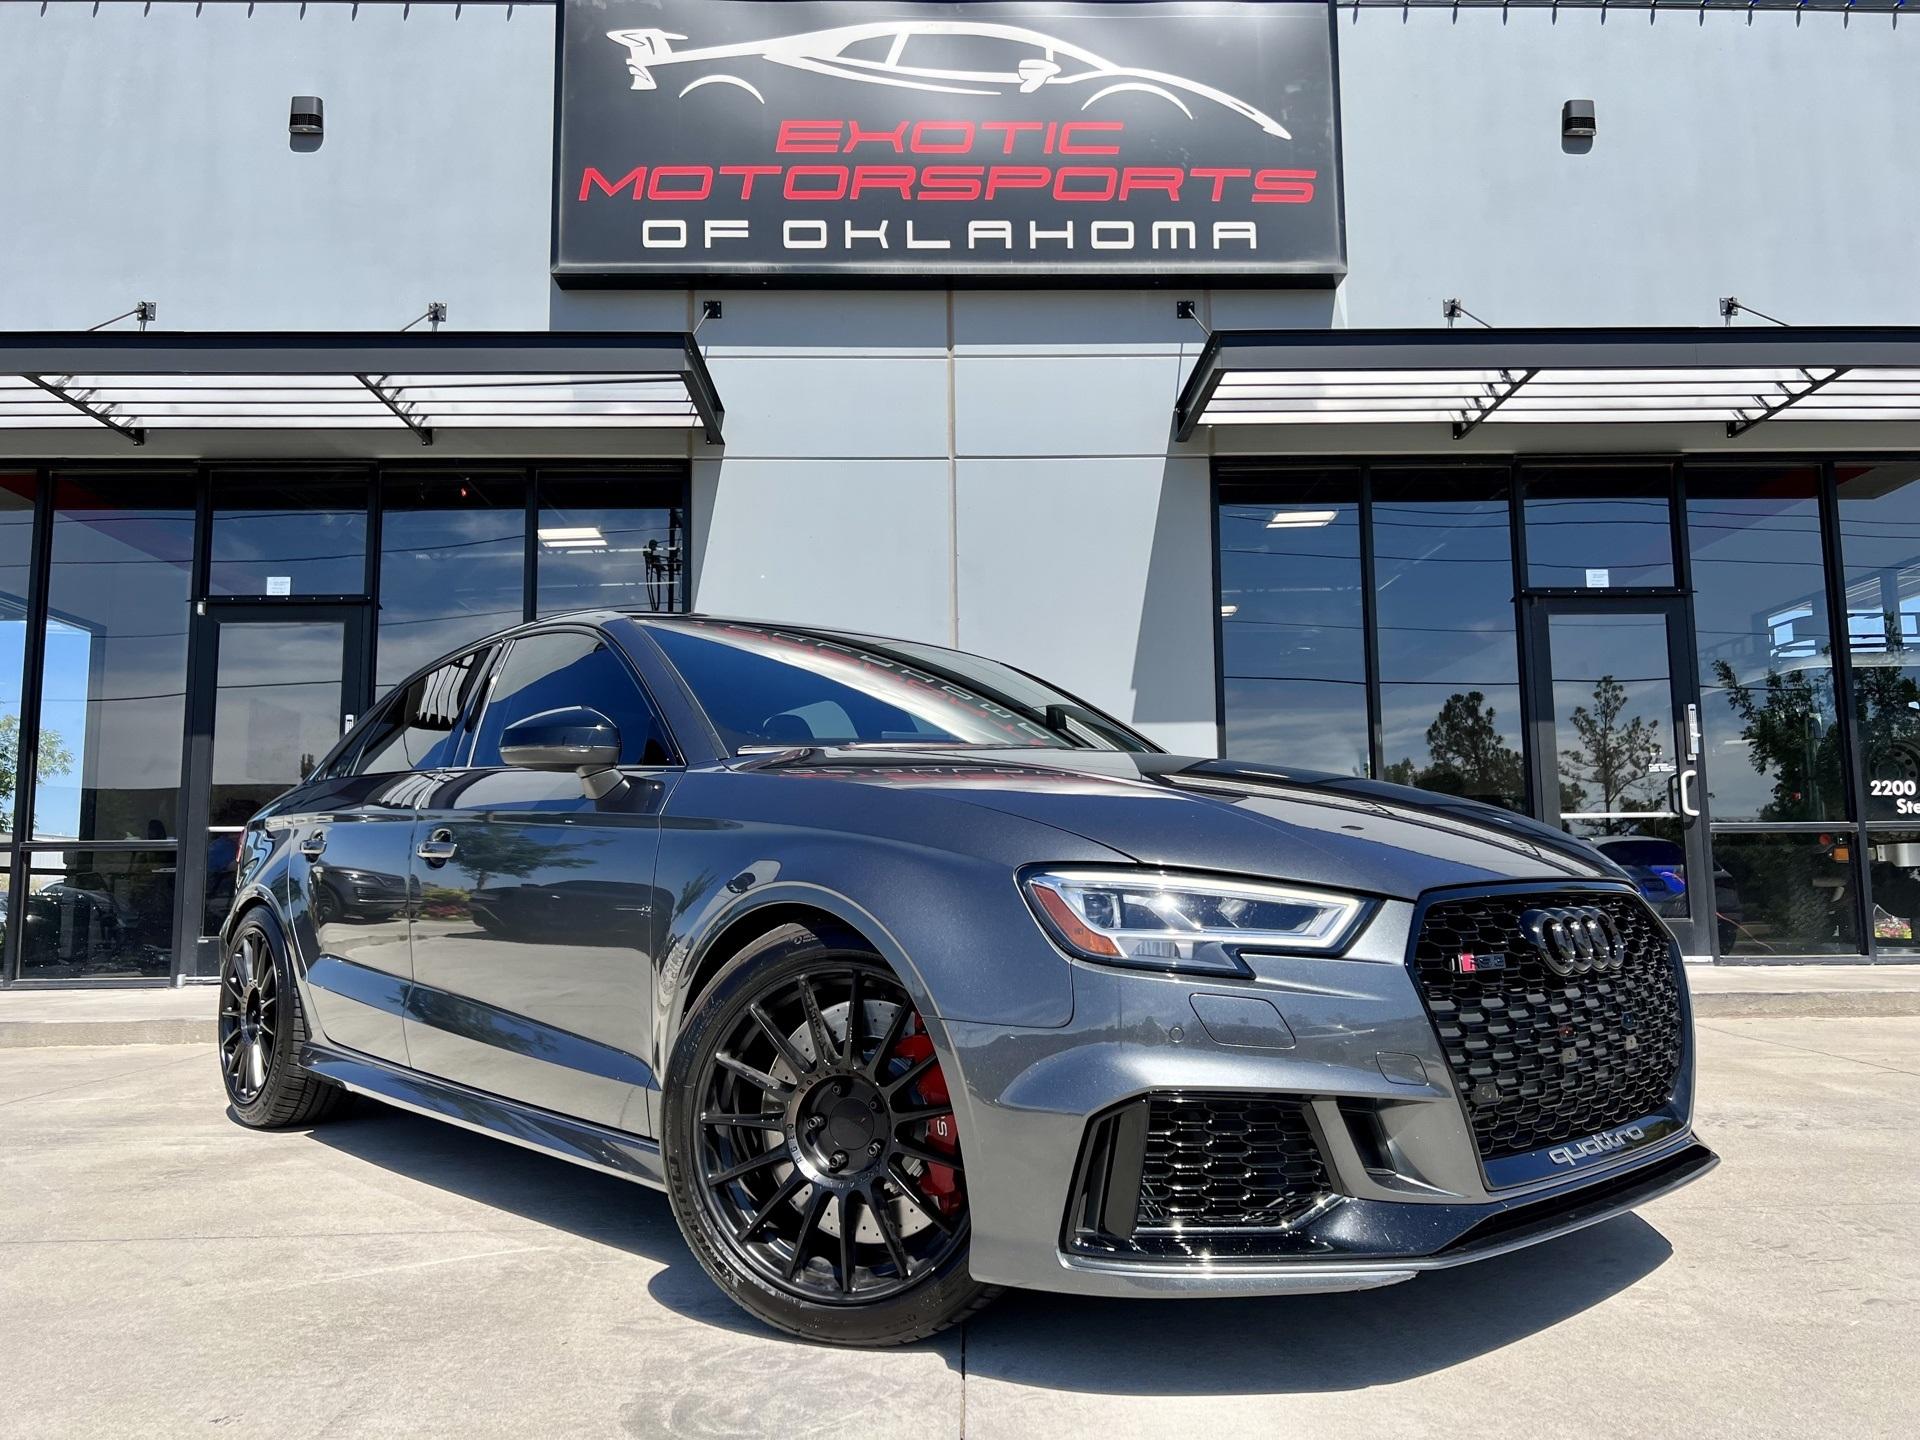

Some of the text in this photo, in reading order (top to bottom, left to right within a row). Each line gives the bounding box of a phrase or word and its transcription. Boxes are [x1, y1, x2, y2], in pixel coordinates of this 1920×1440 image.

[776, 120, 1123, 155] EXOTIC
[579, 165, 1317, 203] MOTORSPORTS
[642, 219, 1258, 250] OF OKLAHOMA
[1870, 780, 1916, 796] 2200
[1896, 798, 1920, 814] Ste
[1548, 1125, 1645, 1166] quattro
